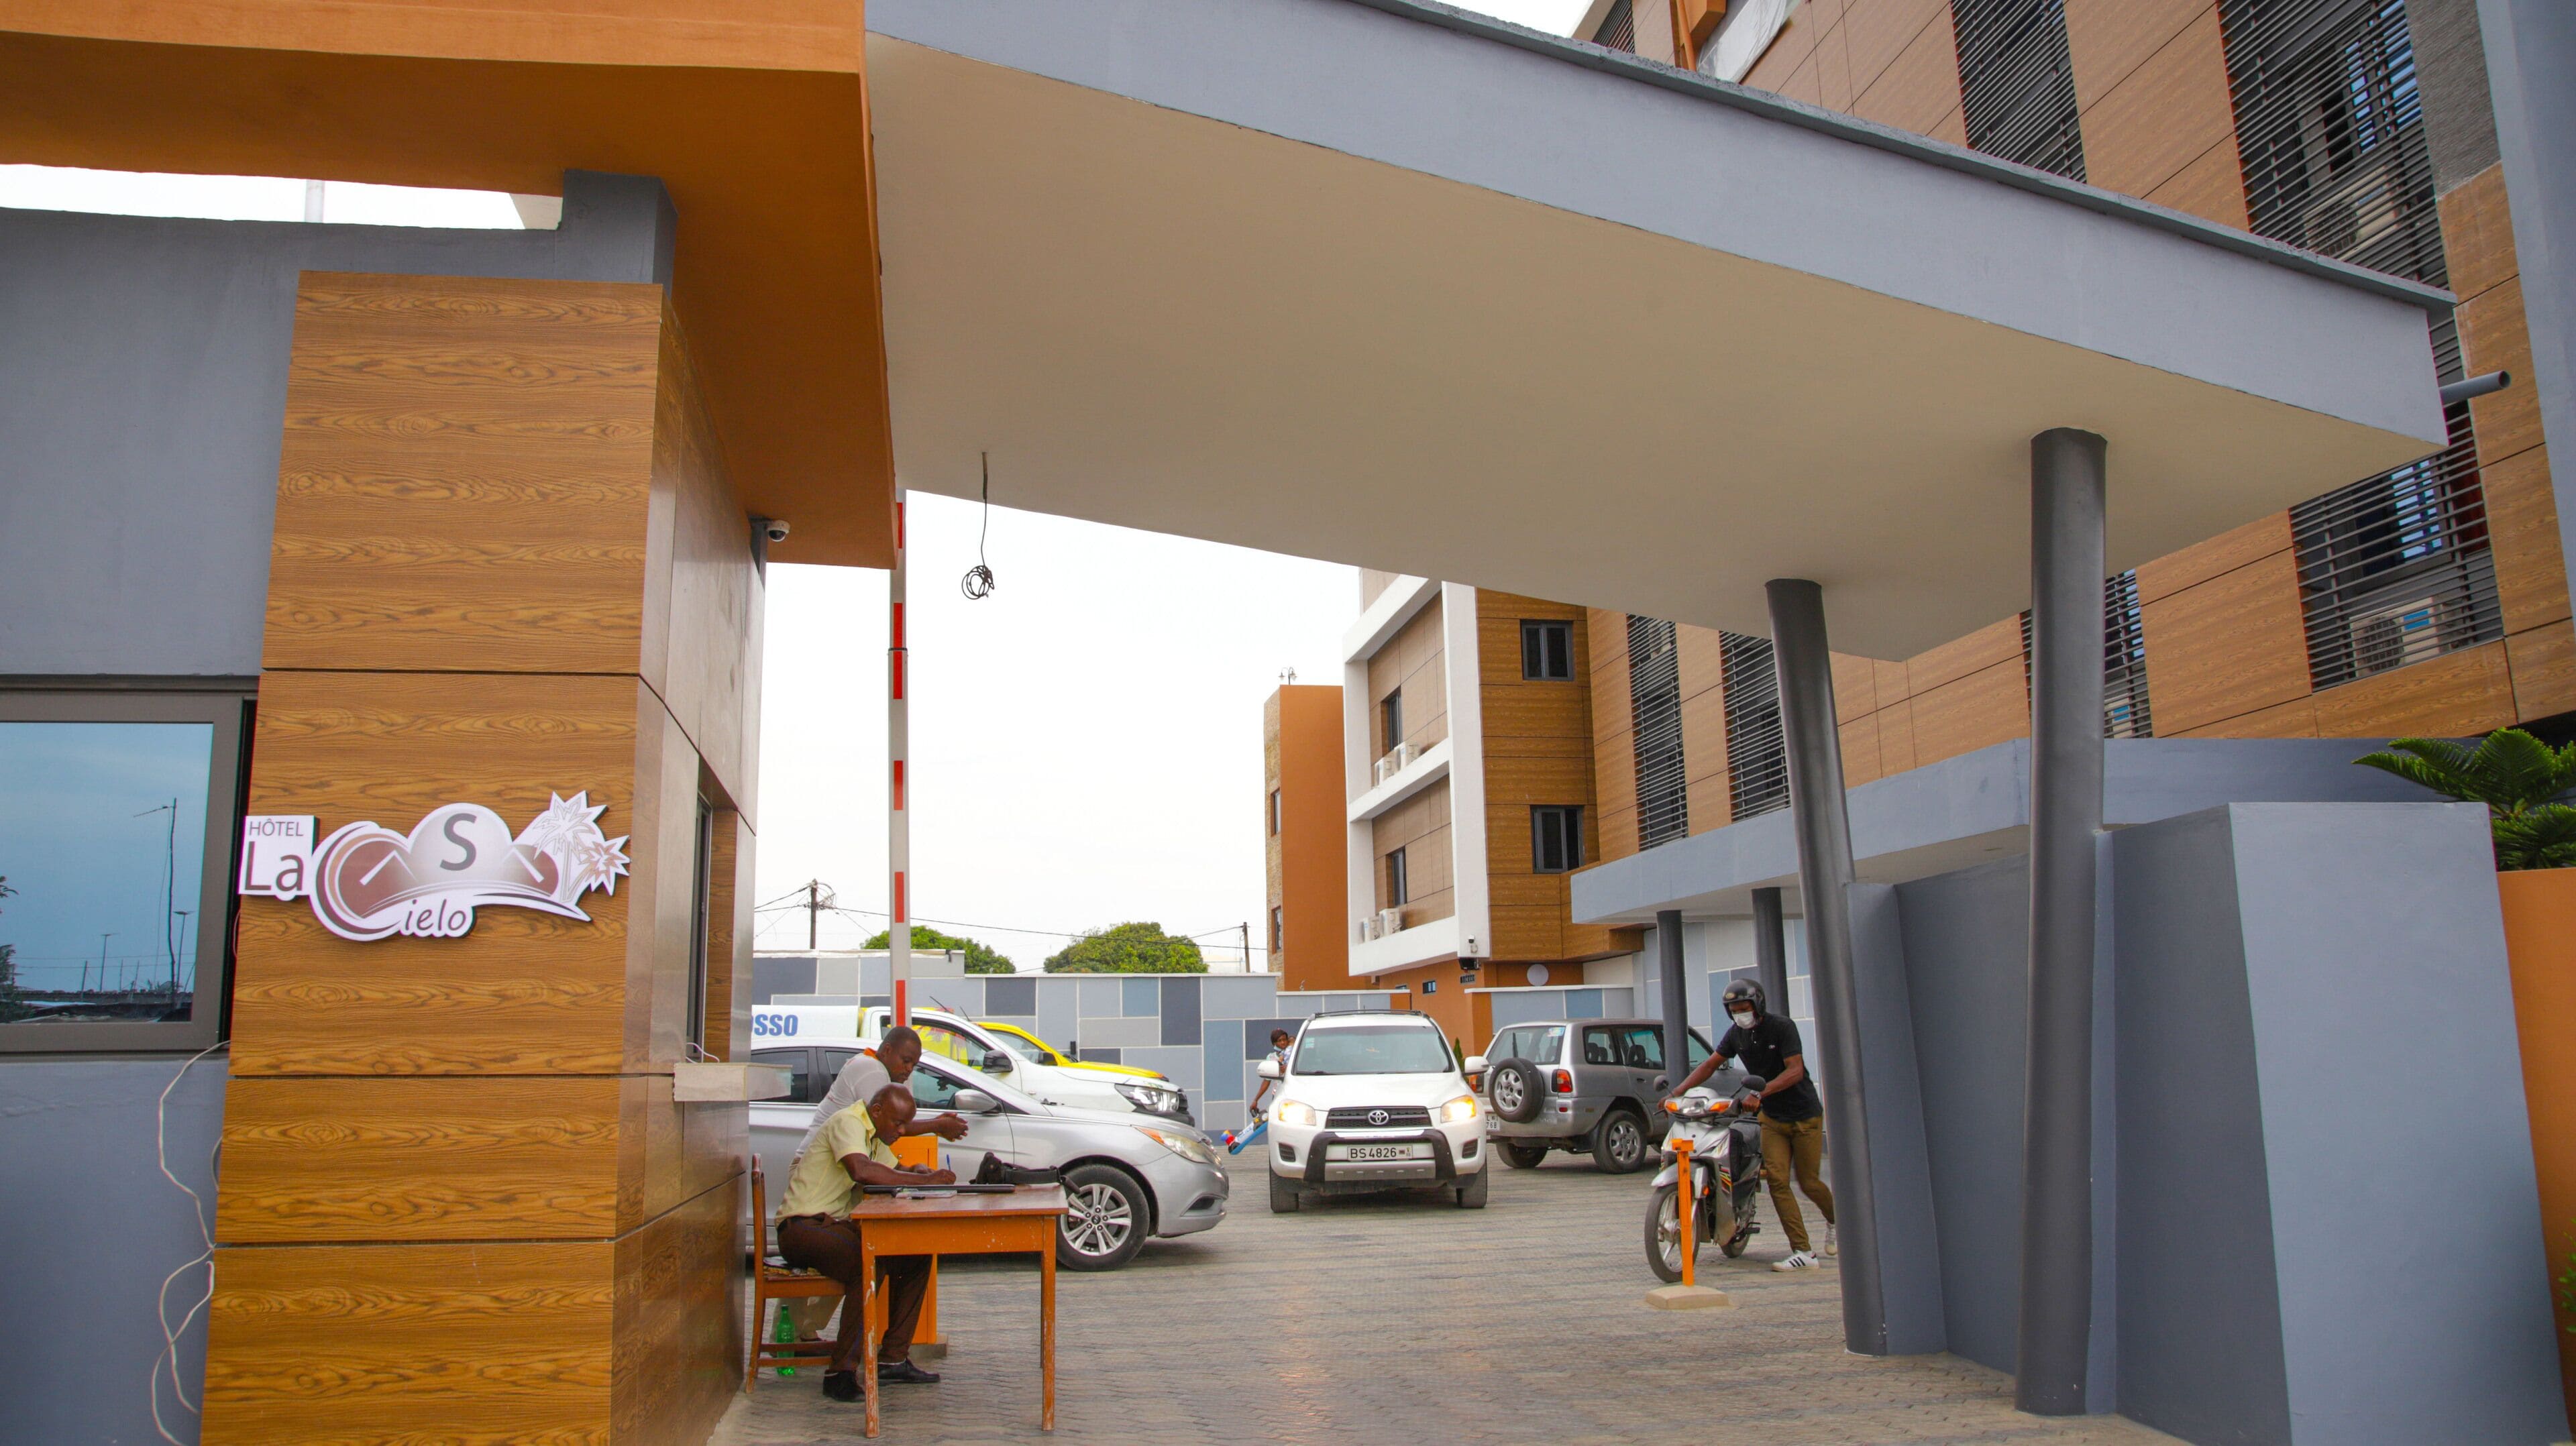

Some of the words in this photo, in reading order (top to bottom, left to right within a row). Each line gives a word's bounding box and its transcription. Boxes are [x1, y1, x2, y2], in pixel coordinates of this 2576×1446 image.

[249, 818, 304, 836] HÔTEL
[244, 840, 305, 892] La
[751, 1013, 798, 1036] SSO
[1350, 1148, 1366, 1159] BS
[1368, 1147, 1397, 1158] 4826
